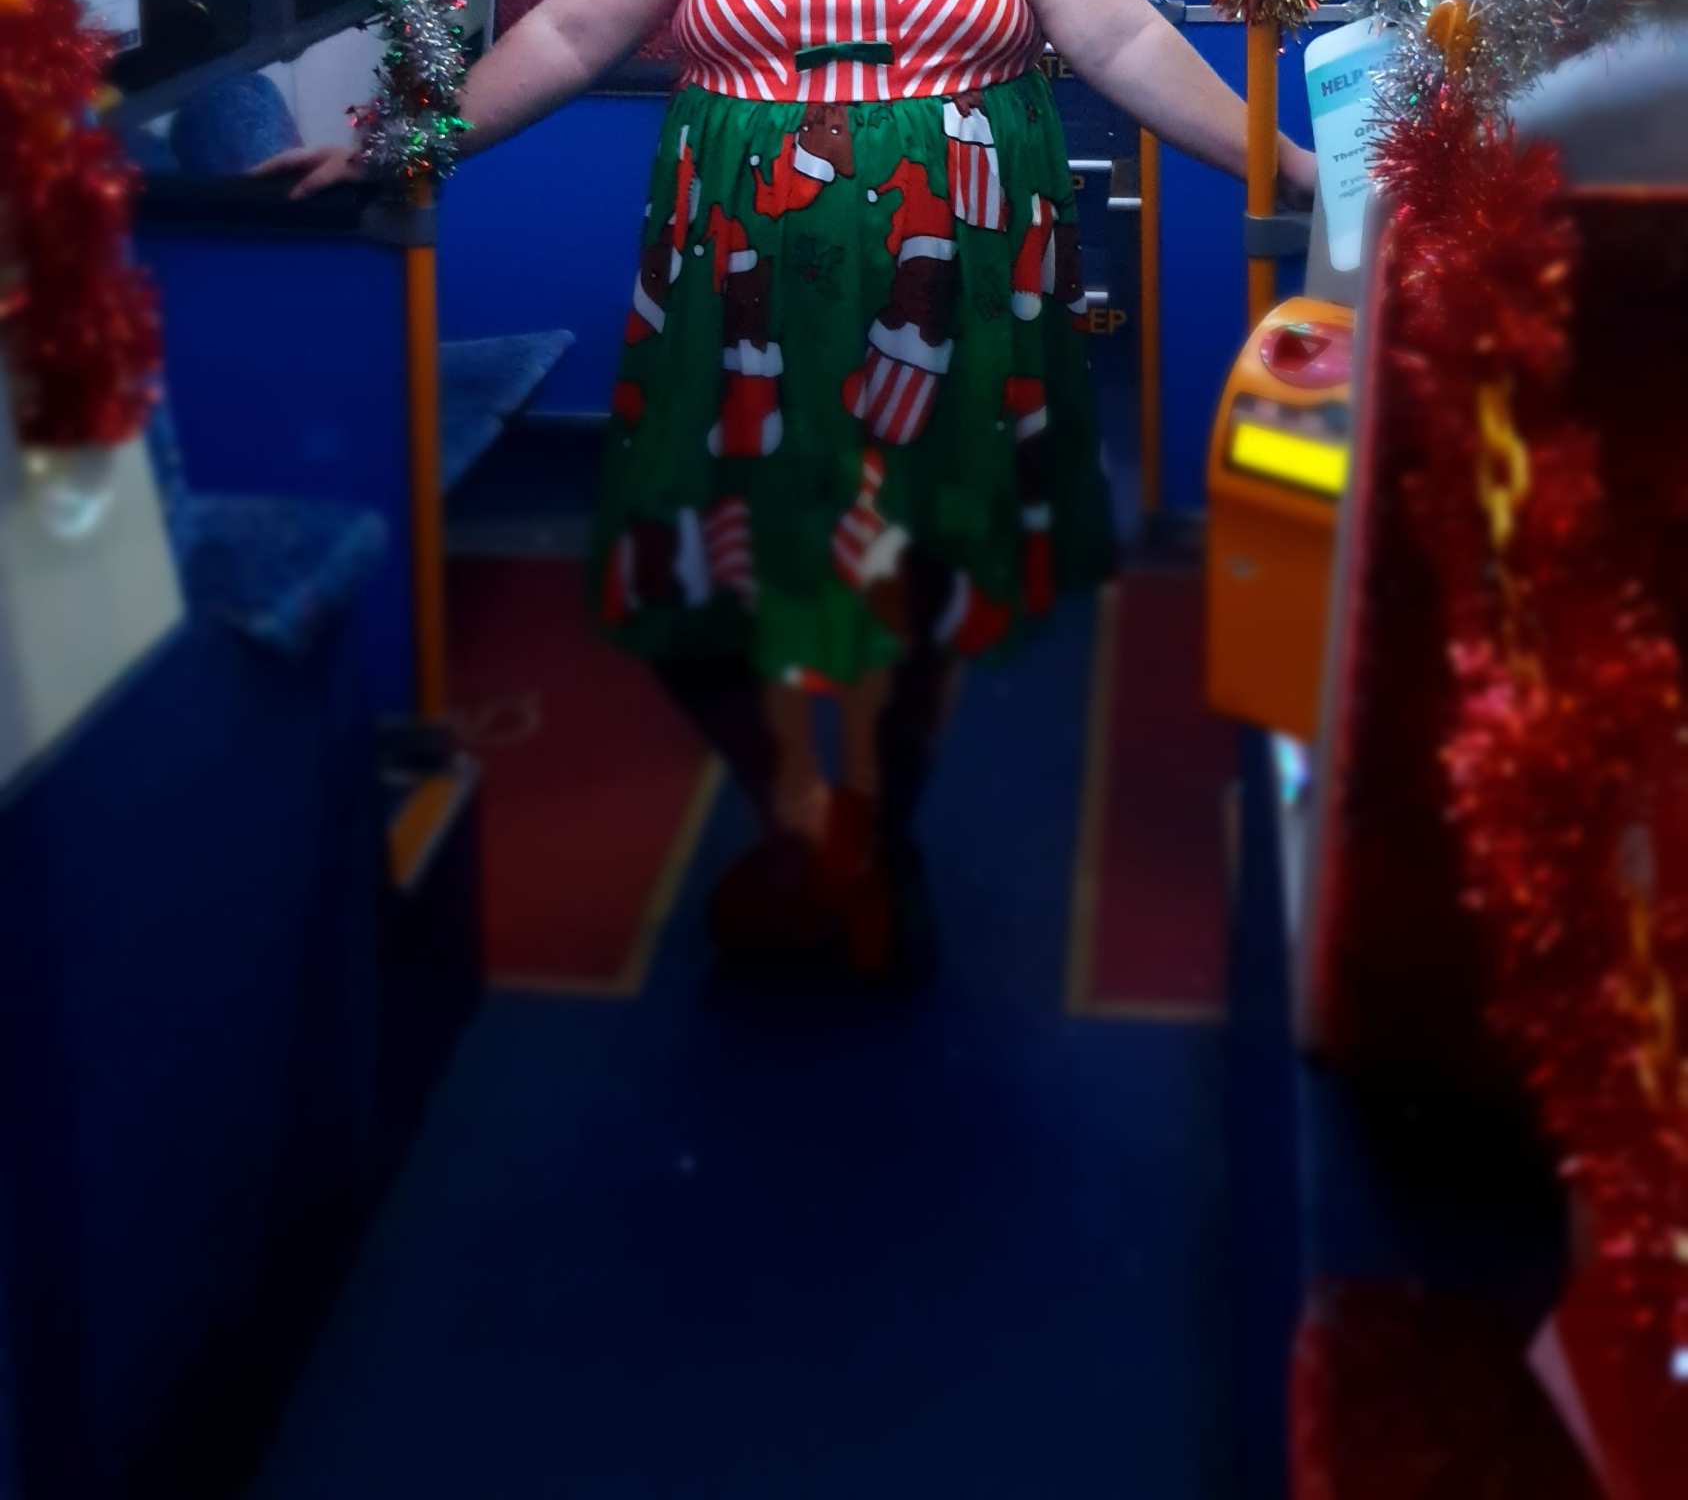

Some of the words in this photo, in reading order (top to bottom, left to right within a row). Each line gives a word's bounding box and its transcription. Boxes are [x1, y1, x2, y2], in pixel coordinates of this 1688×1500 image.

[1042, 56, 1075, 78] TE
[1320, 69, 1364, 97] HELP
[1088, 307, 1127, 332] EP
